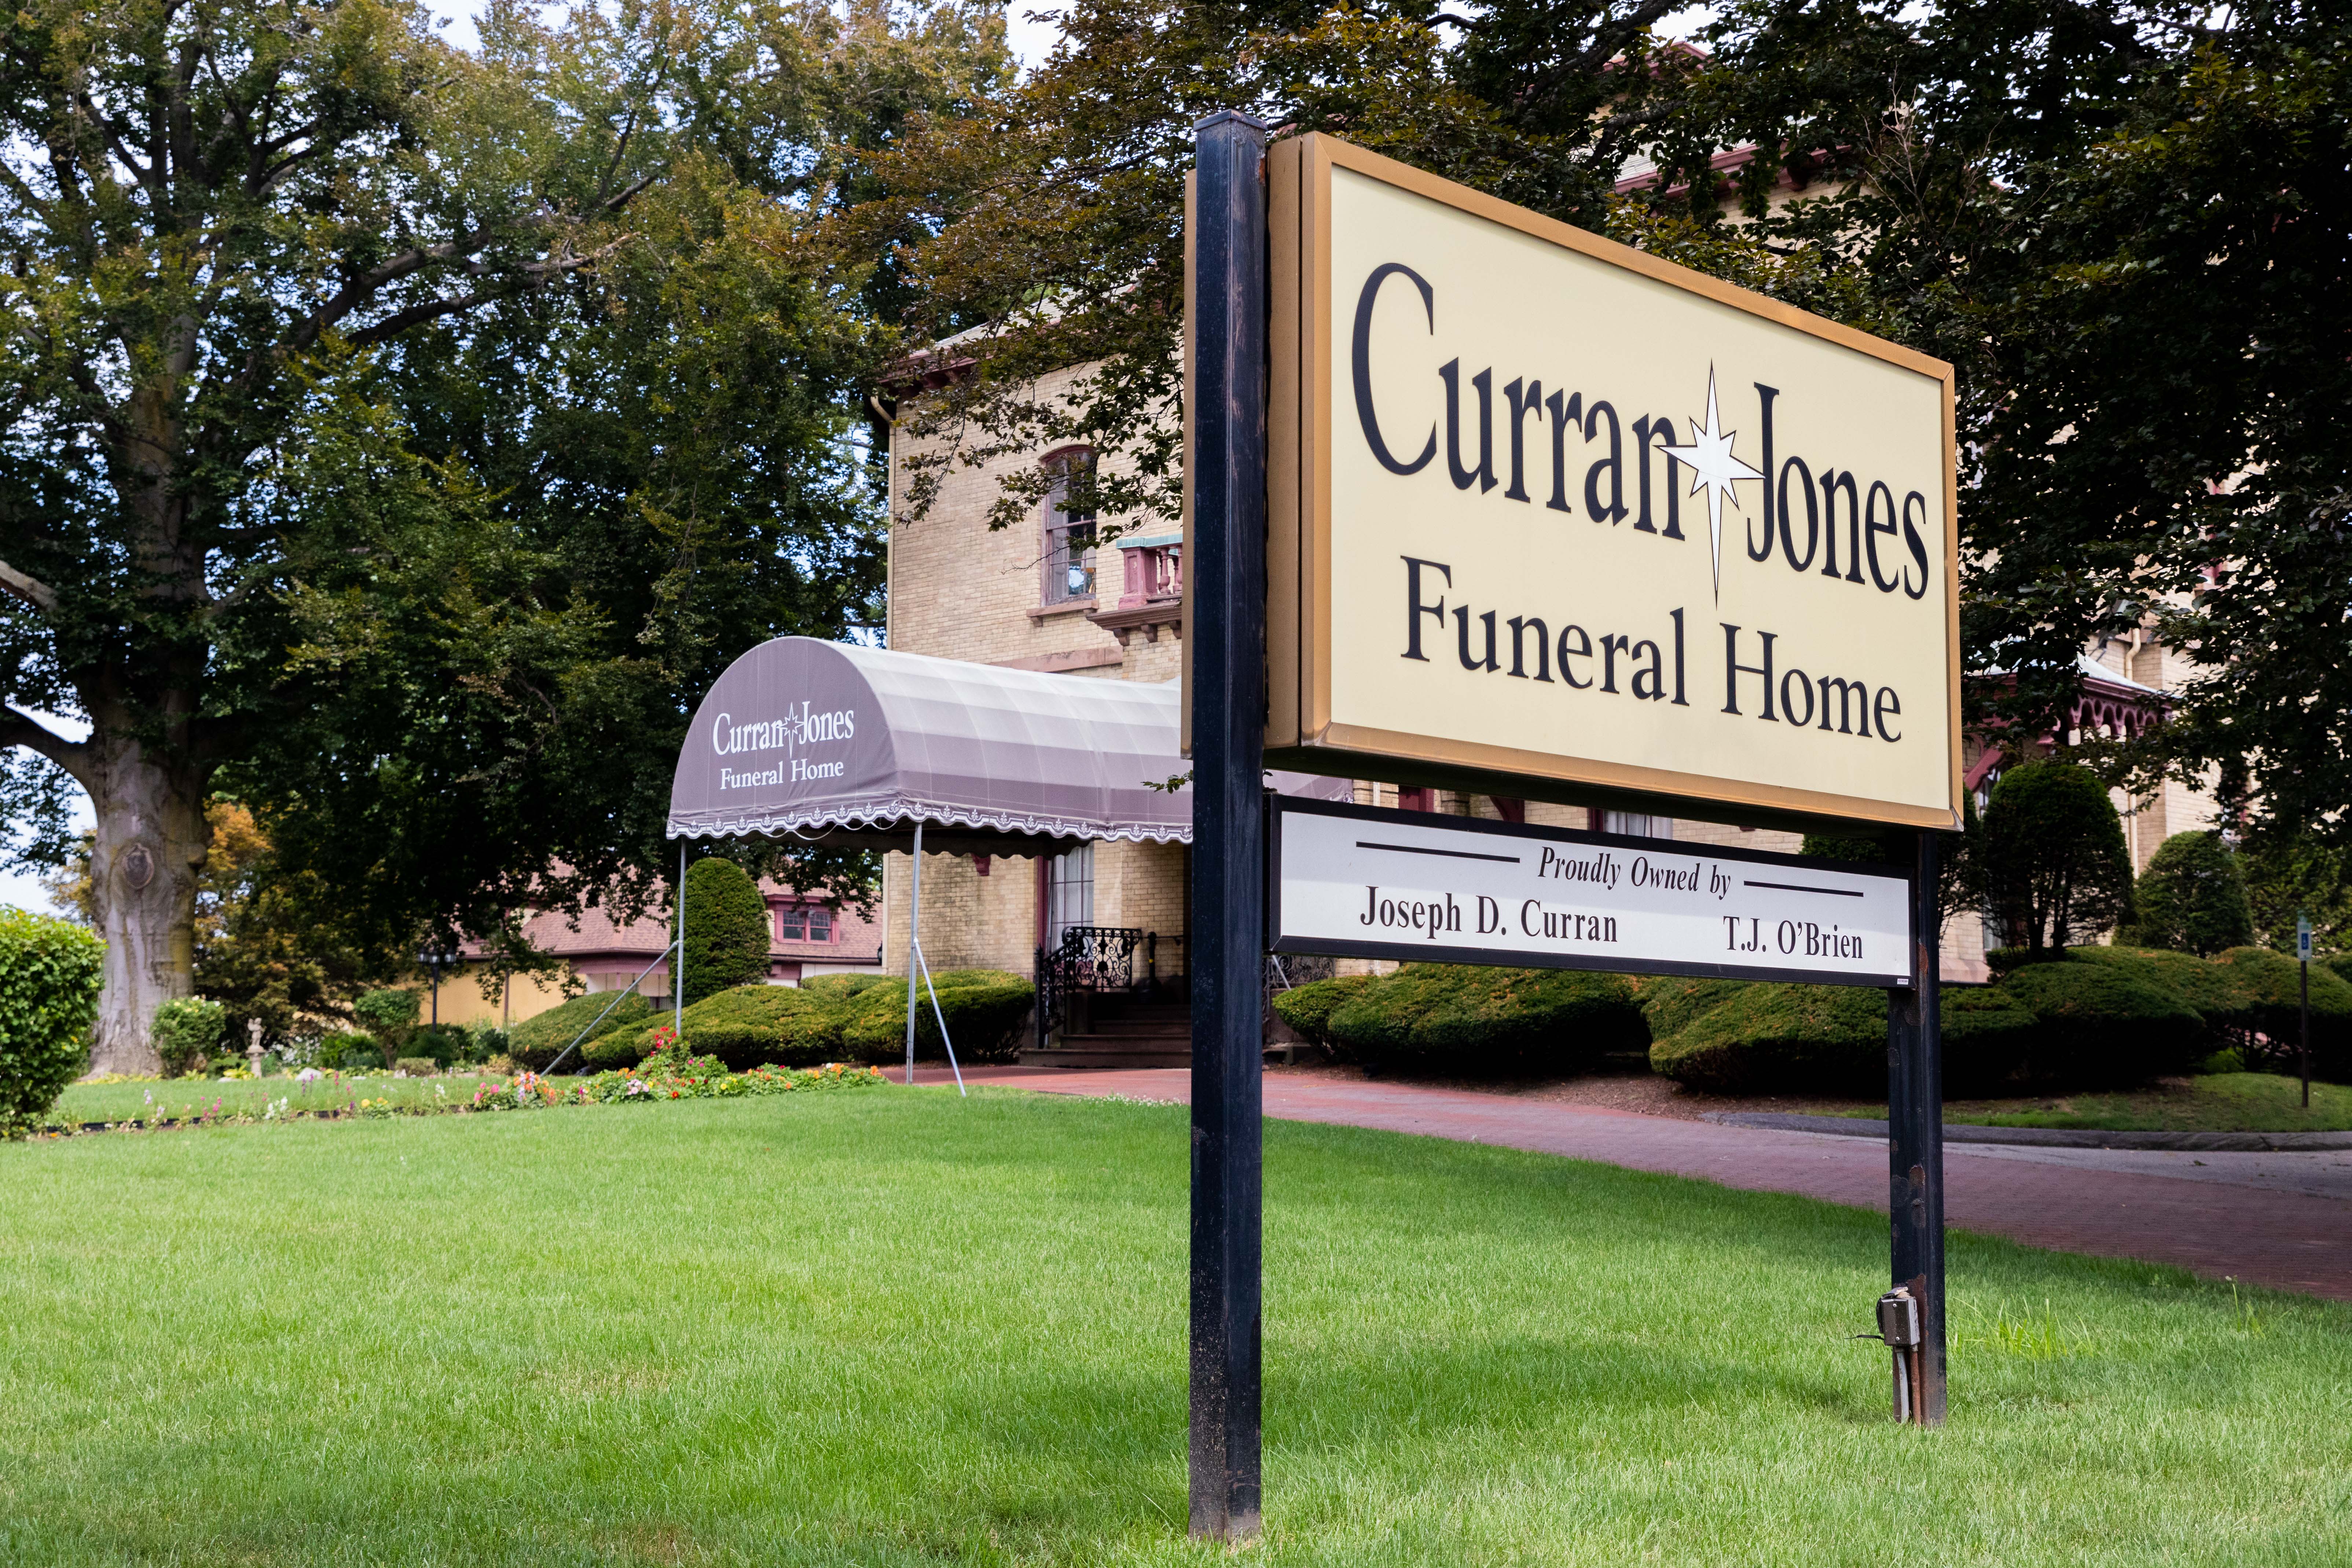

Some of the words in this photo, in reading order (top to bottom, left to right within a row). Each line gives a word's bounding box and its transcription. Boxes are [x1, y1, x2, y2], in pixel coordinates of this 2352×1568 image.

[1351, 262, 1685, 541] Curran
[1747, 381, 1929, 601] Jones
[1400, 555, 1690, 707] Funeral
[1719, 622, 1902, 743] Home
[712, 712, 784, 756] Curran
[799, 701, 854, 745] Jones
[720, 761, 784, 790] Funeral
[790, 758, 844, 782] Home
[1537, 846, 1621, 891] Proudly
[1631, 856, 1701, 892] Owned
[1709, 864, 1731, 901] by
[1360, 885, 1462, 940] Joseph
[1475, 895, 1507, 936] D.
[1520, 899, 1618, 943] Curran
[1723, 915, 1766, 952] T.J.
[1777, 920, 1863, 959] O'Brien
